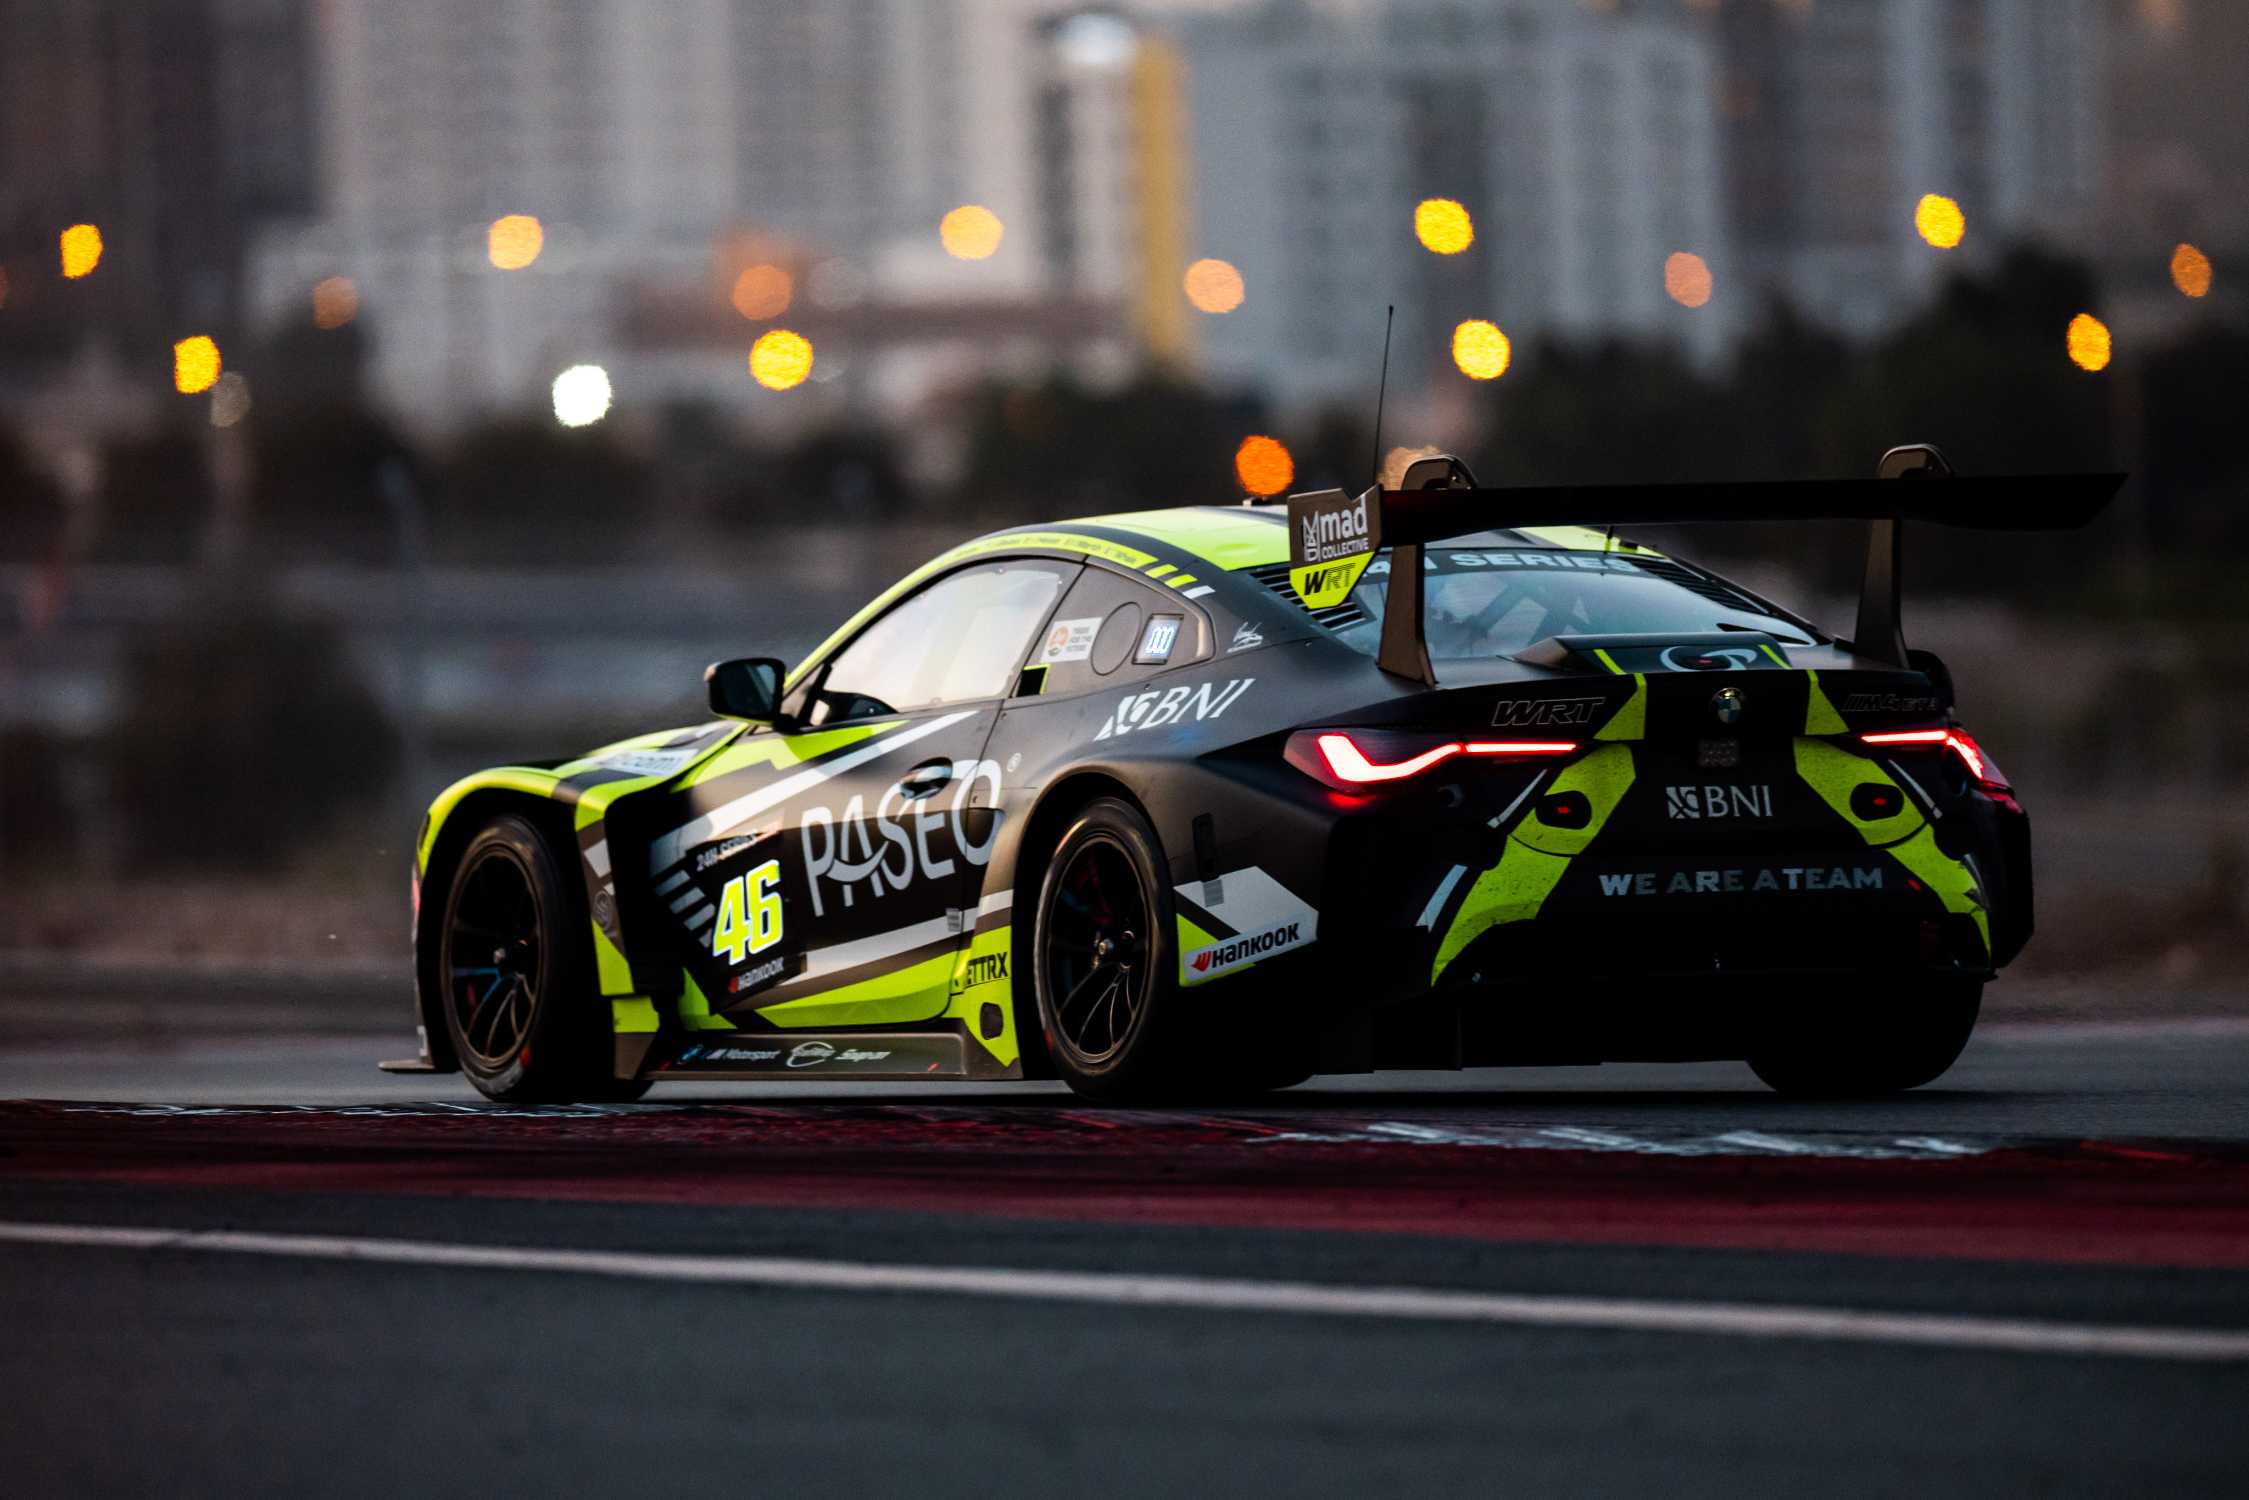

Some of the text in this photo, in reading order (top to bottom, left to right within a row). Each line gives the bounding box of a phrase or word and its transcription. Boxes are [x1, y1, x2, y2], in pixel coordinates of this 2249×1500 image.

[1320, 495, 1369, 543] mad
[1303, 562, 1357, 596] WRT
[1453, 553, 1640, 573] SERIES
[1490, 696, 1607, 726] WRT
[1704, 784, 1774, 818] BNI
[801, 758, 1002, 918] PASEO
[1600, 872, 1657, 897] WE
[1666, 869, 1745, 893] ARE
[712, 858, 784, 966] 46
